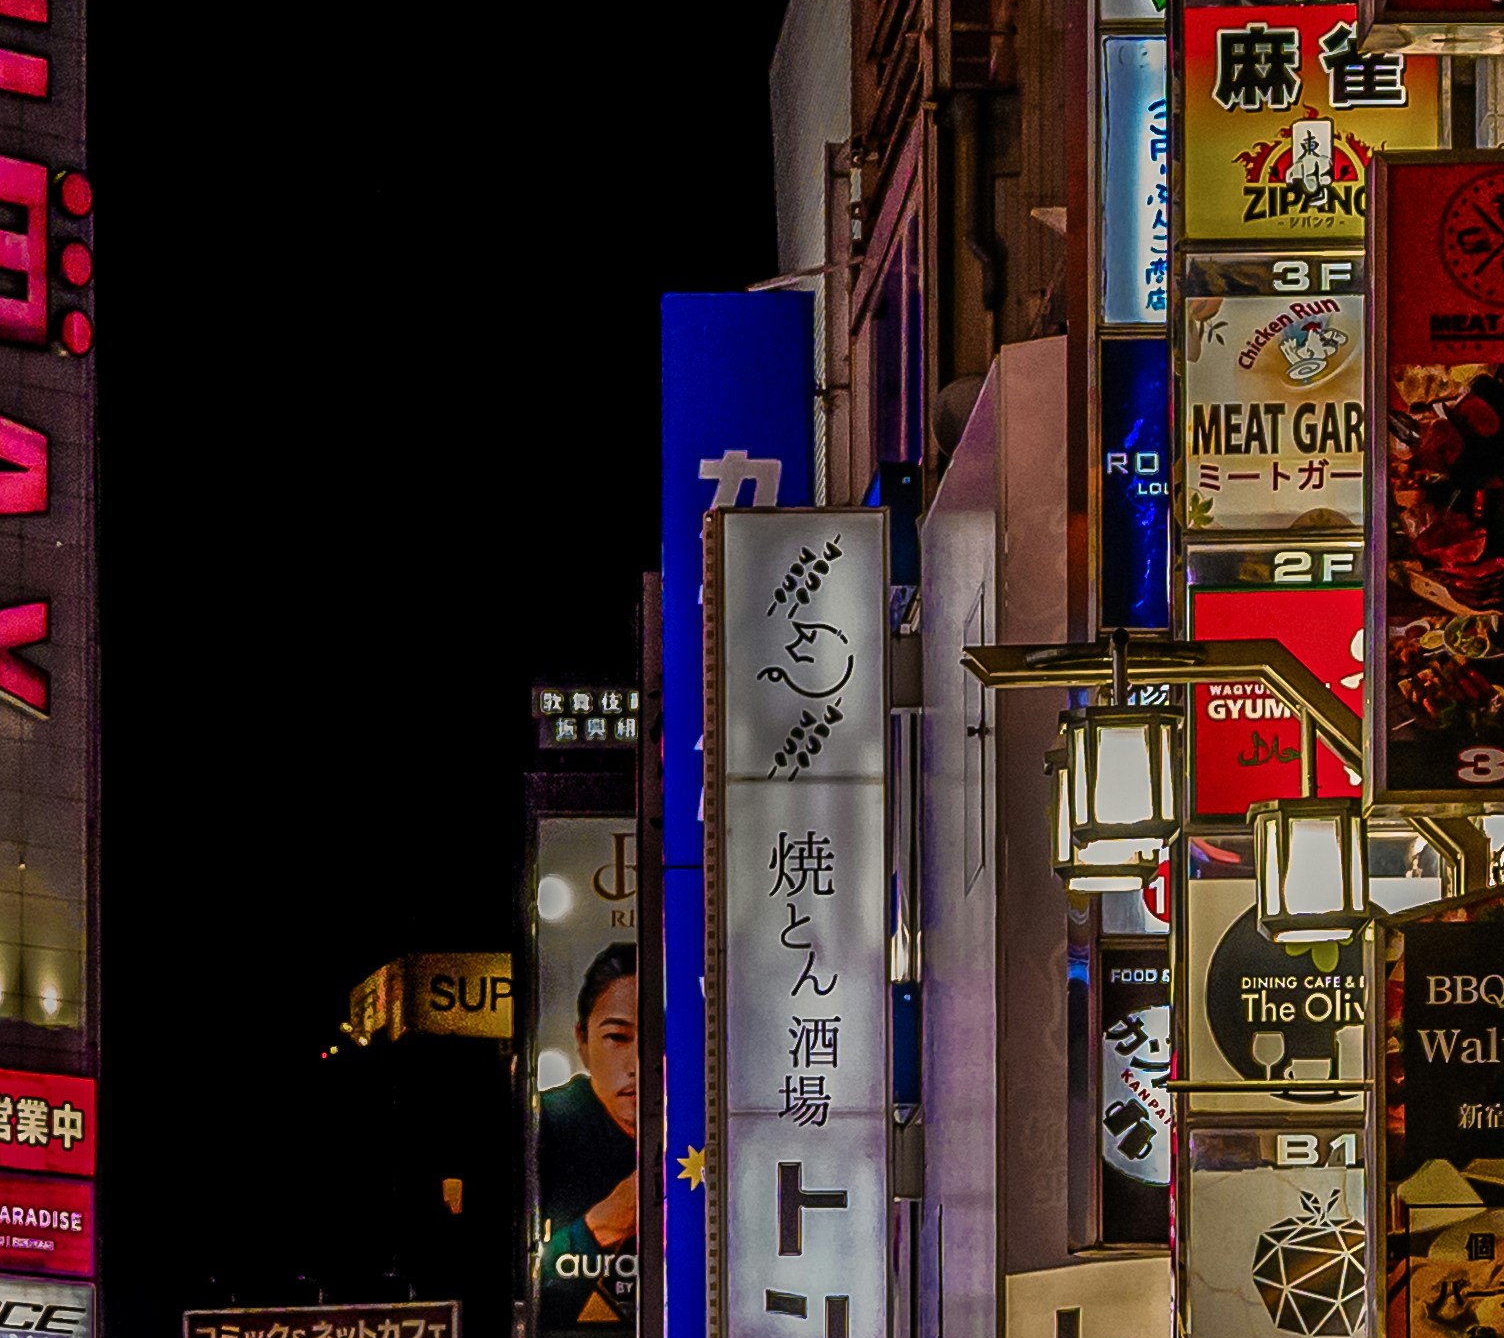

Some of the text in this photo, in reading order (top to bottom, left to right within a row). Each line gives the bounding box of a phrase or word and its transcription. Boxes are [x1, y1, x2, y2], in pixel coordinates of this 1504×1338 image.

[1214, 24, 1408, 113] 麻雀
[1272, 262, 1352, 292] 3F
[1237, 295, 1341, 371] Chicken Run
[1430, 314, 1500, 333] MEAT
[1192, 401, 1286, 458] MEAT
[1272, 551, 1353, 583] 2F
[1241, 975, 1342, 990] DINING CAFE
[1241, 992, 1298, 1024] The
[1277, 1135, 1356, 1165] B1
